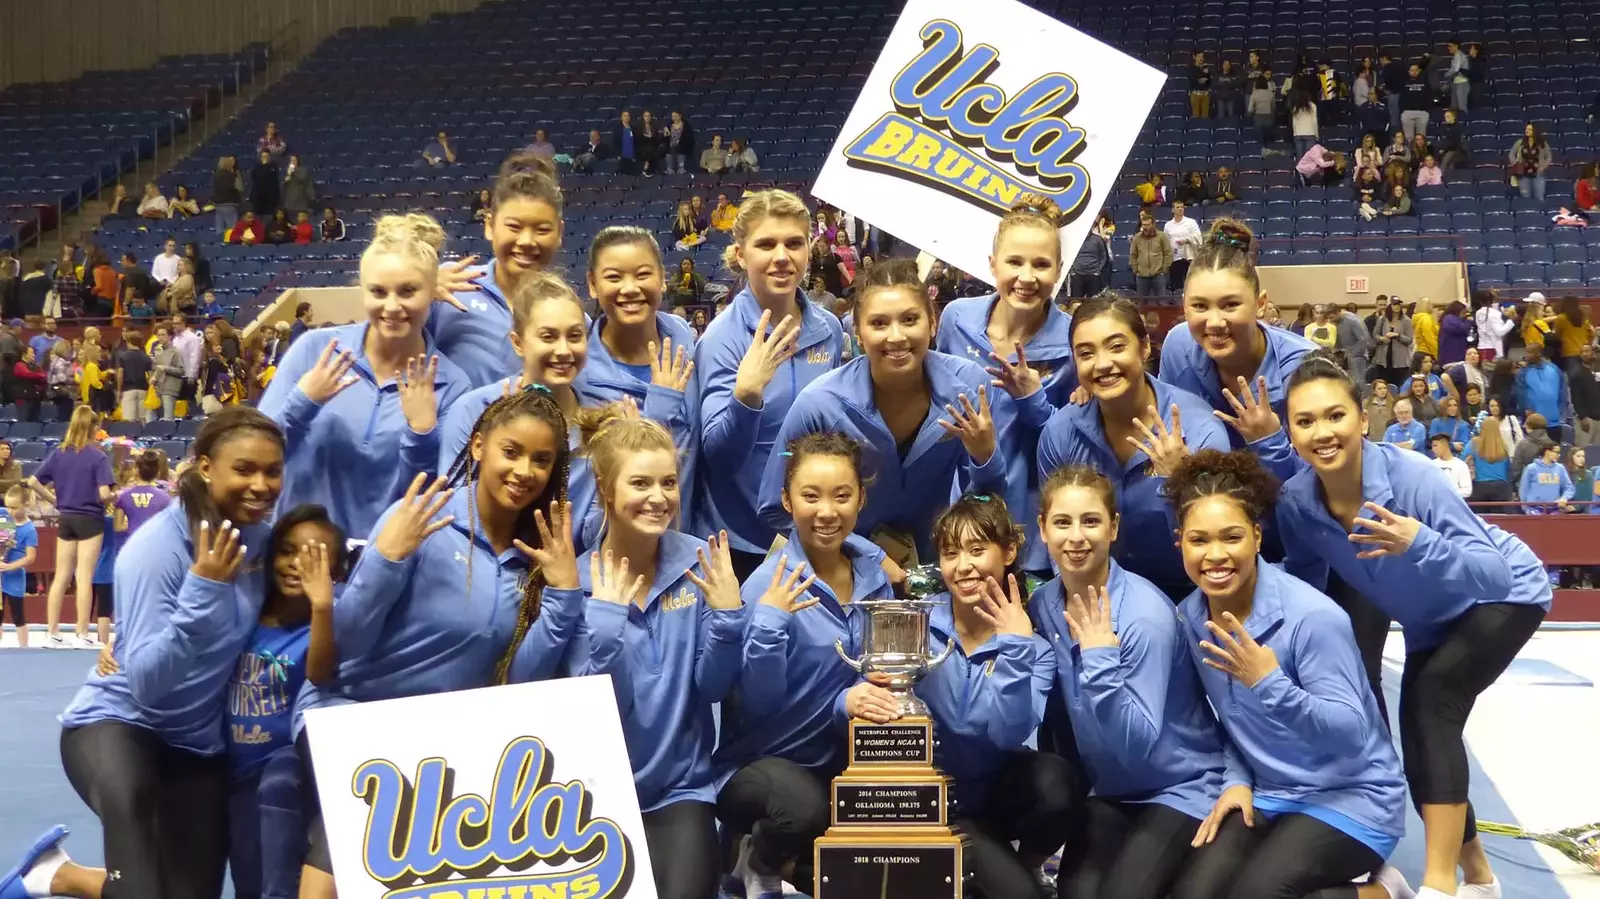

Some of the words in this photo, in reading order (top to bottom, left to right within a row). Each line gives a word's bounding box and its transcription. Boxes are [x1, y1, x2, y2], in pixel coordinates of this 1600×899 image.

[863, 120, 1026, 204] BRUIN
[1350, 279, 1366, 291] EXIT
[131, 492, 154, 508] W
[853, 856, 869, 864] 2018
[873, 856, 920, 864] CHAMPIONS
